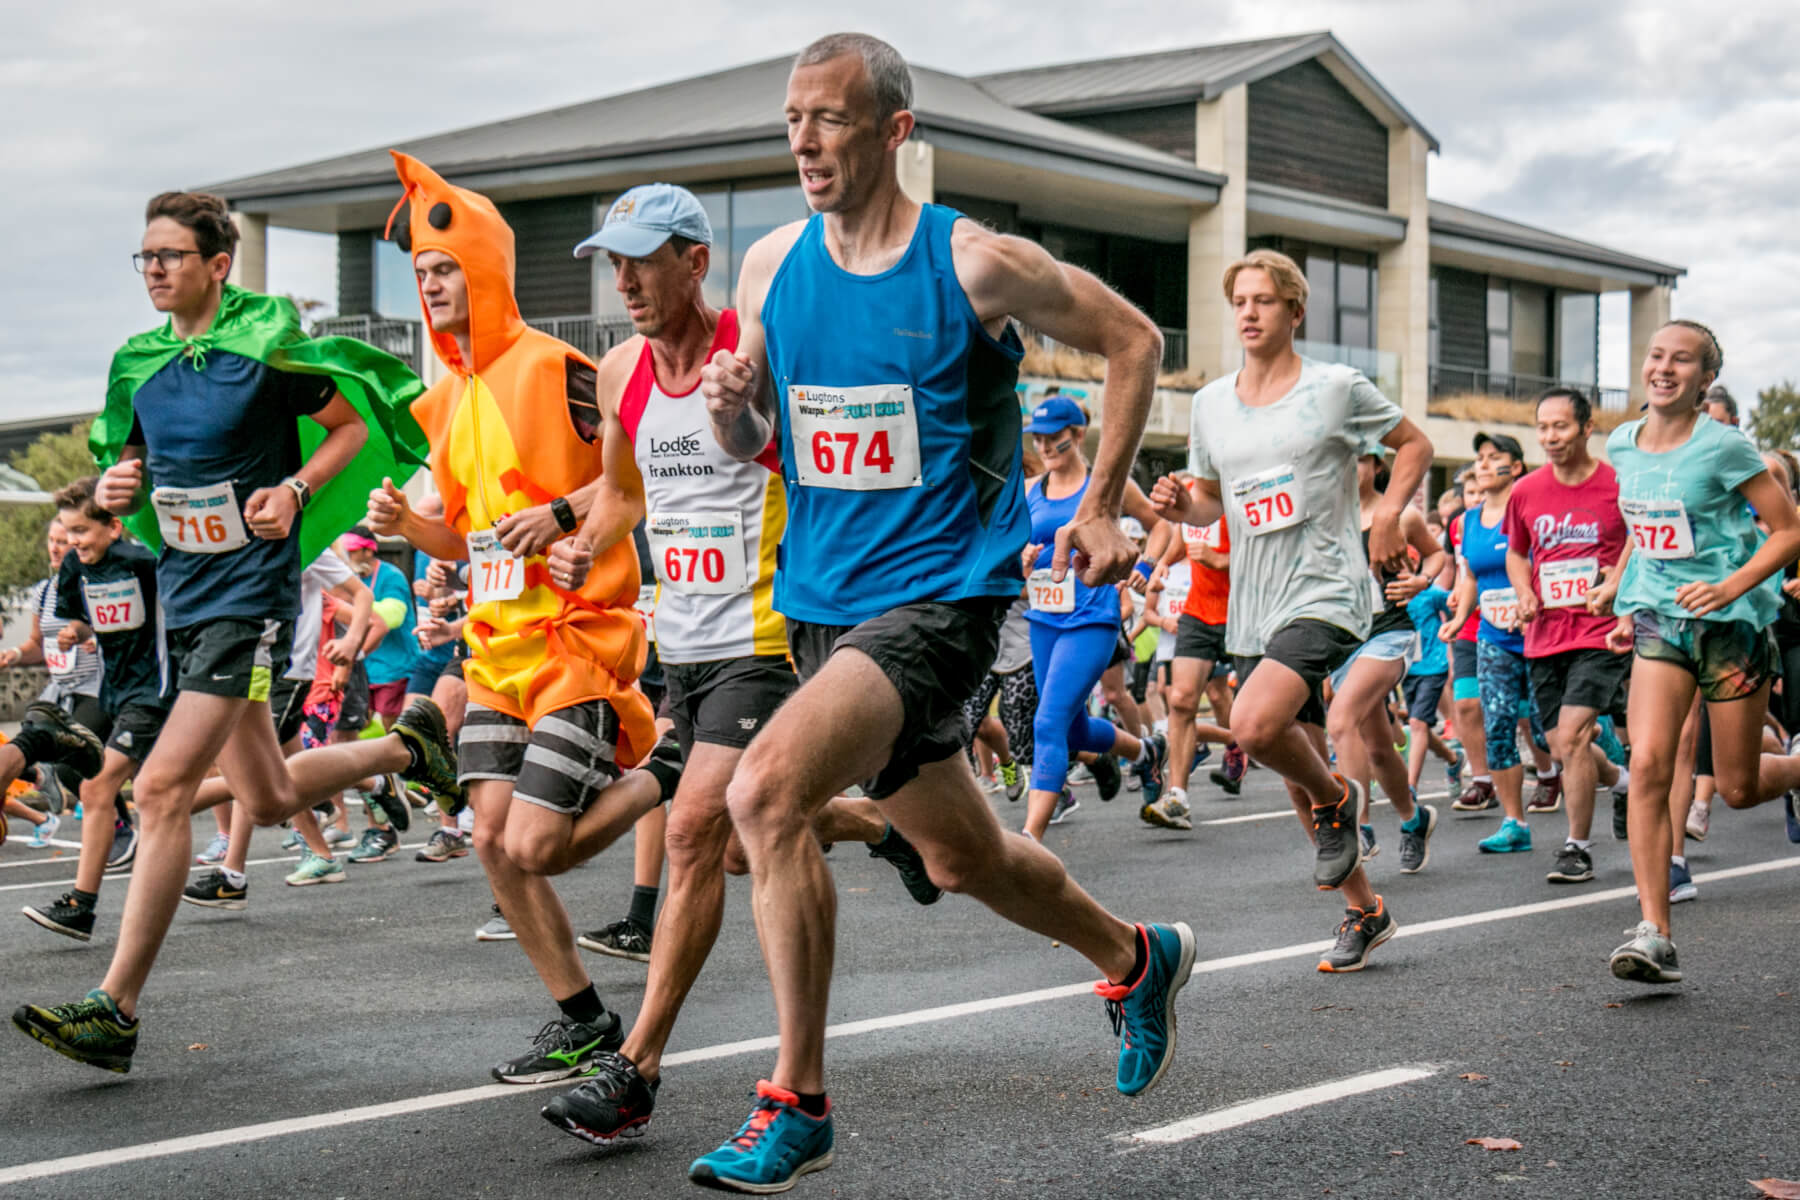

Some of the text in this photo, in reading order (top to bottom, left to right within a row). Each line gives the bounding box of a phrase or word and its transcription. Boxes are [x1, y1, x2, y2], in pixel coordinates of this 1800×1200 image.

[806, 390, 845, 404] Lugtons
[650, 435, 700, 456] Lodge
[812, 430, 894, 475] 674
[649, 463, 715, 477] Frankton
[1244, 491, 1294, 527] 570
[170, 515, 227, 544] 716
[1632, 524, 1679, 550] 572
[481, 558, 514, 592] 717
[665, 546, 725, 583] 670
[1034, 587, 1064, 605] 720
[1550, 577, 1590, 600] 578
[95, 602, 131, 625] 627
